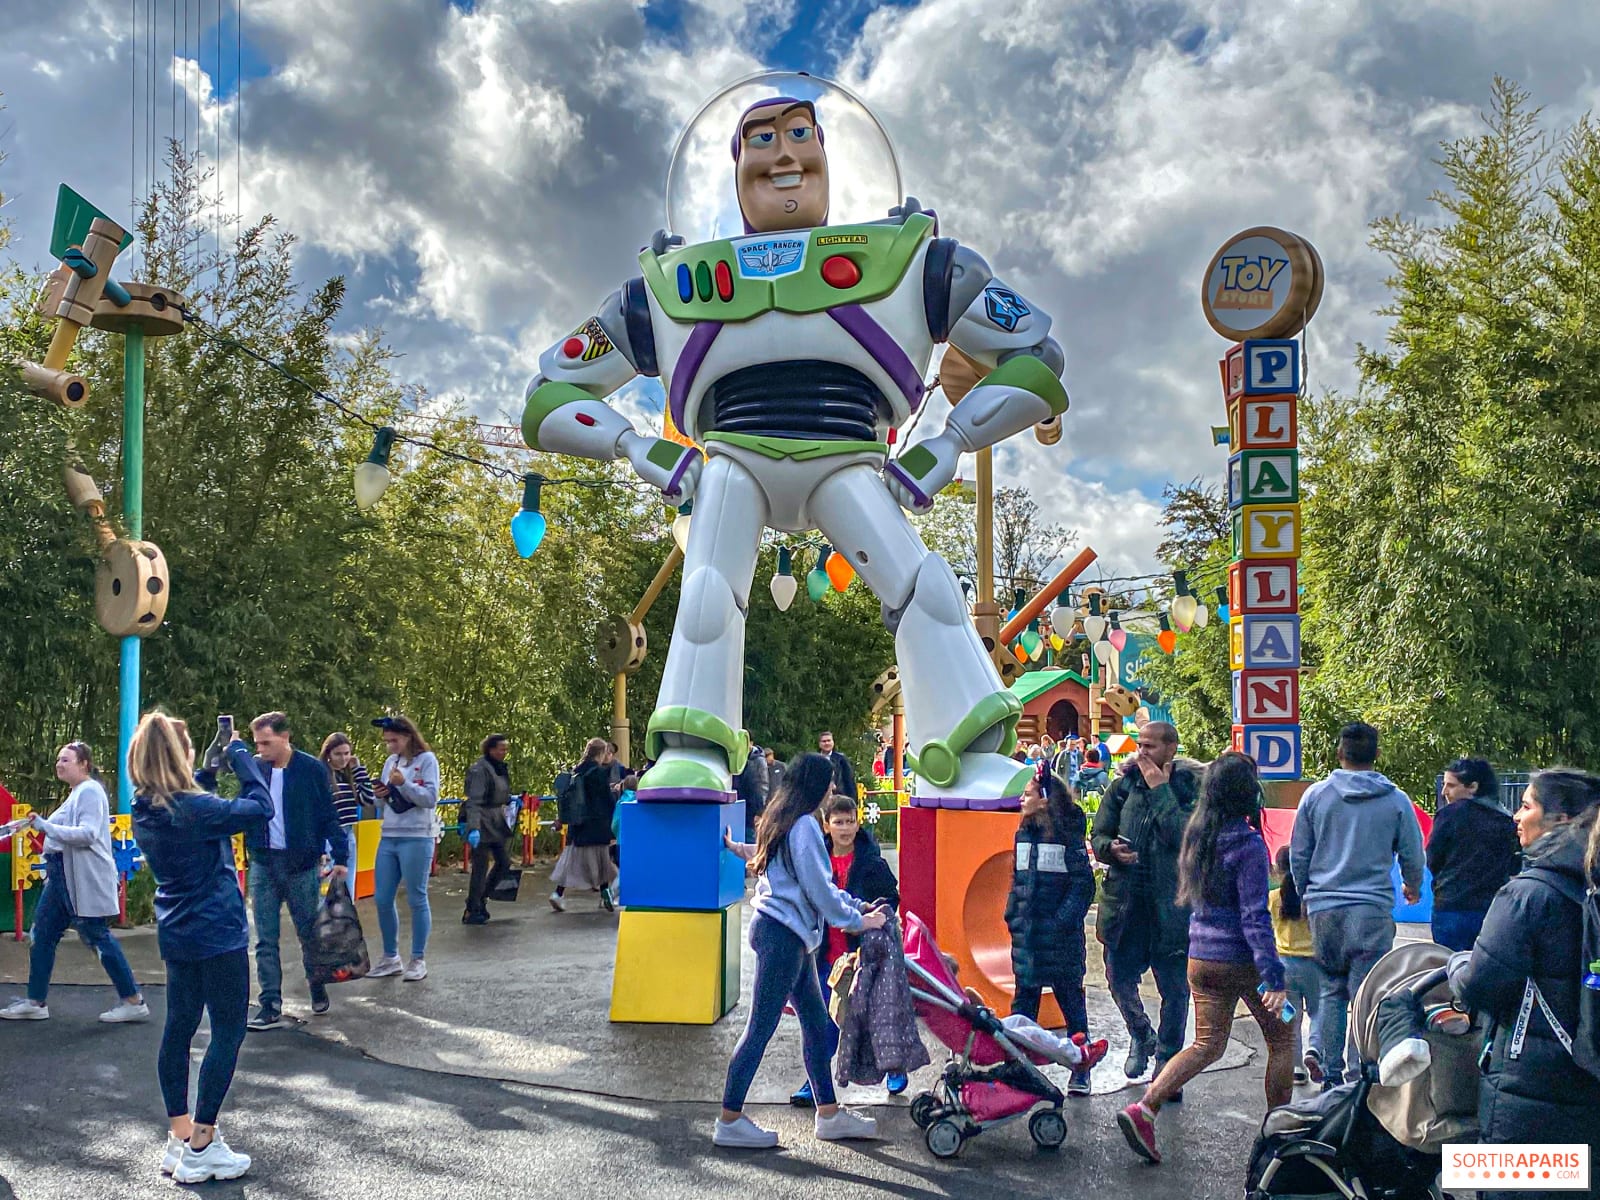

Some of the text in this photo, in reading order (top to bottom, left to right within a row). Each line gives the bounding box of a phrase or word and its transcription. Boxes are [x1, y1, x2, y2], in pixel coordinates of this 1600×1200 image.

[742, 241, 802, 253] SPACE RANGER
[818, 236, 867, 245] LIGHTYEAR
[1221, 256, 1289, 292] TOY
[1220, 291, 1269, 305] STORY
